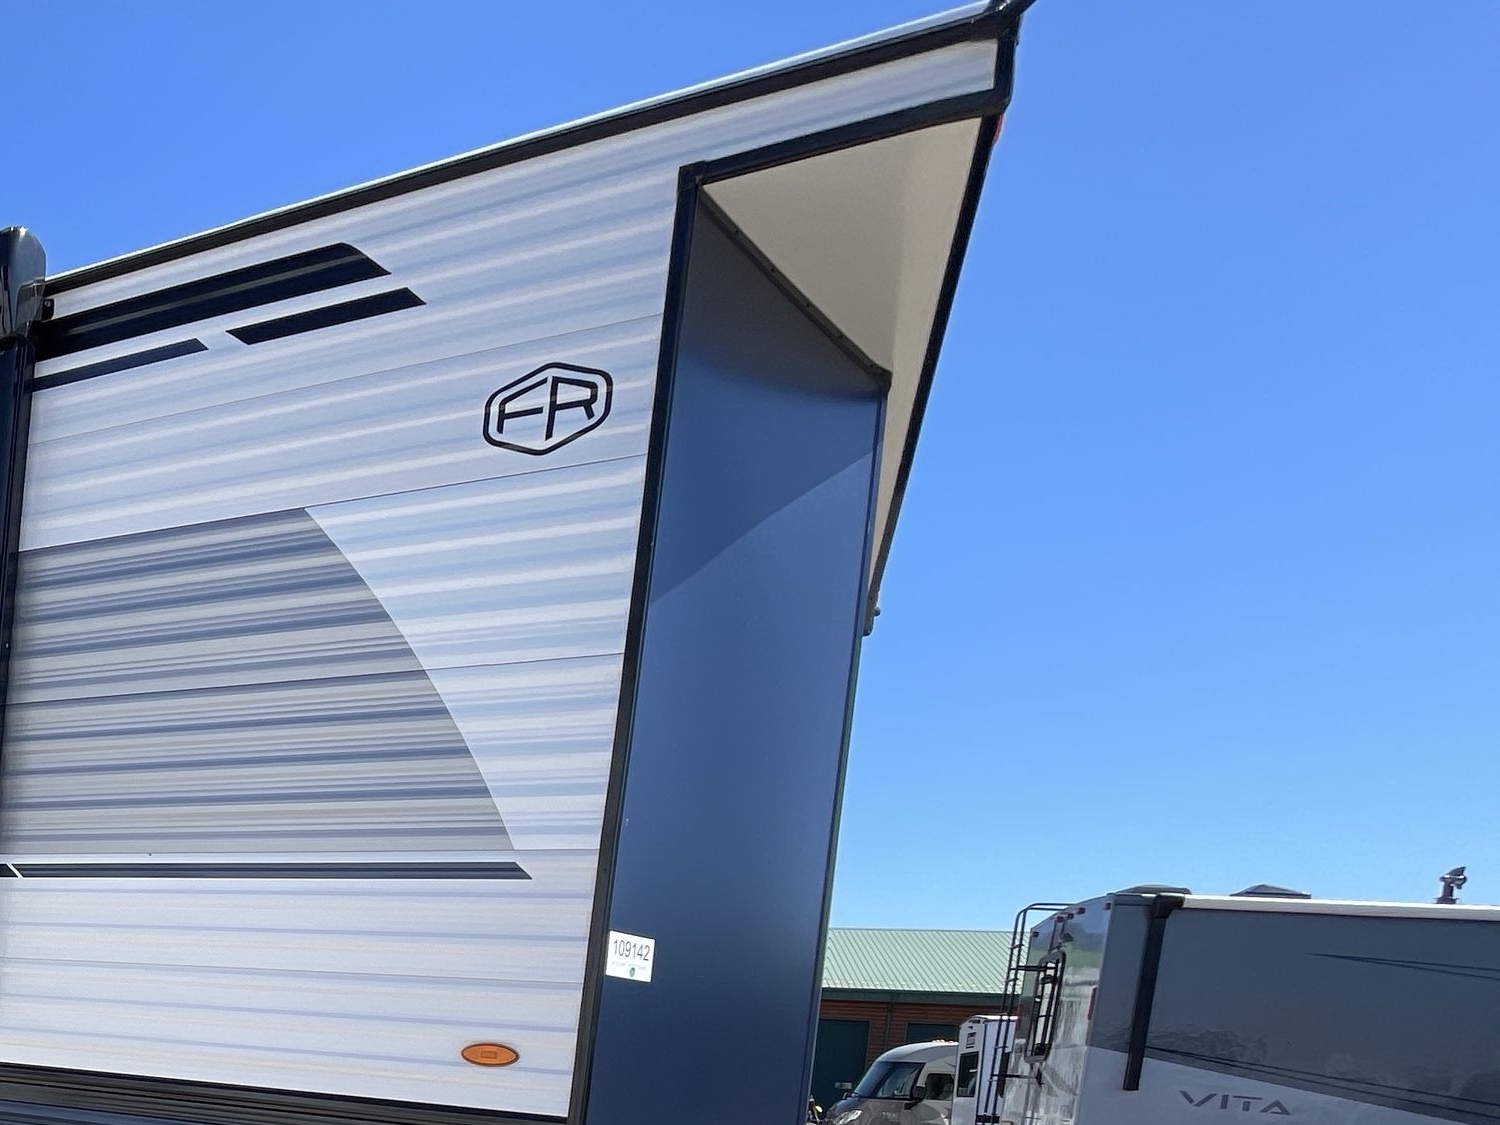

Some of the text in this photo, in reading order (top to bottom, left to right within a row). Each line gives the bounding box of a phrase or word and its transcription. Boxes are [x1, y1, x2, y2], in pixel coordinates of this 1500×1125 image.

[496, 375, 599, 441] FR
[613, 939, 651, 962] 109142
[1179, 1089, 1292, 1116] VITA
